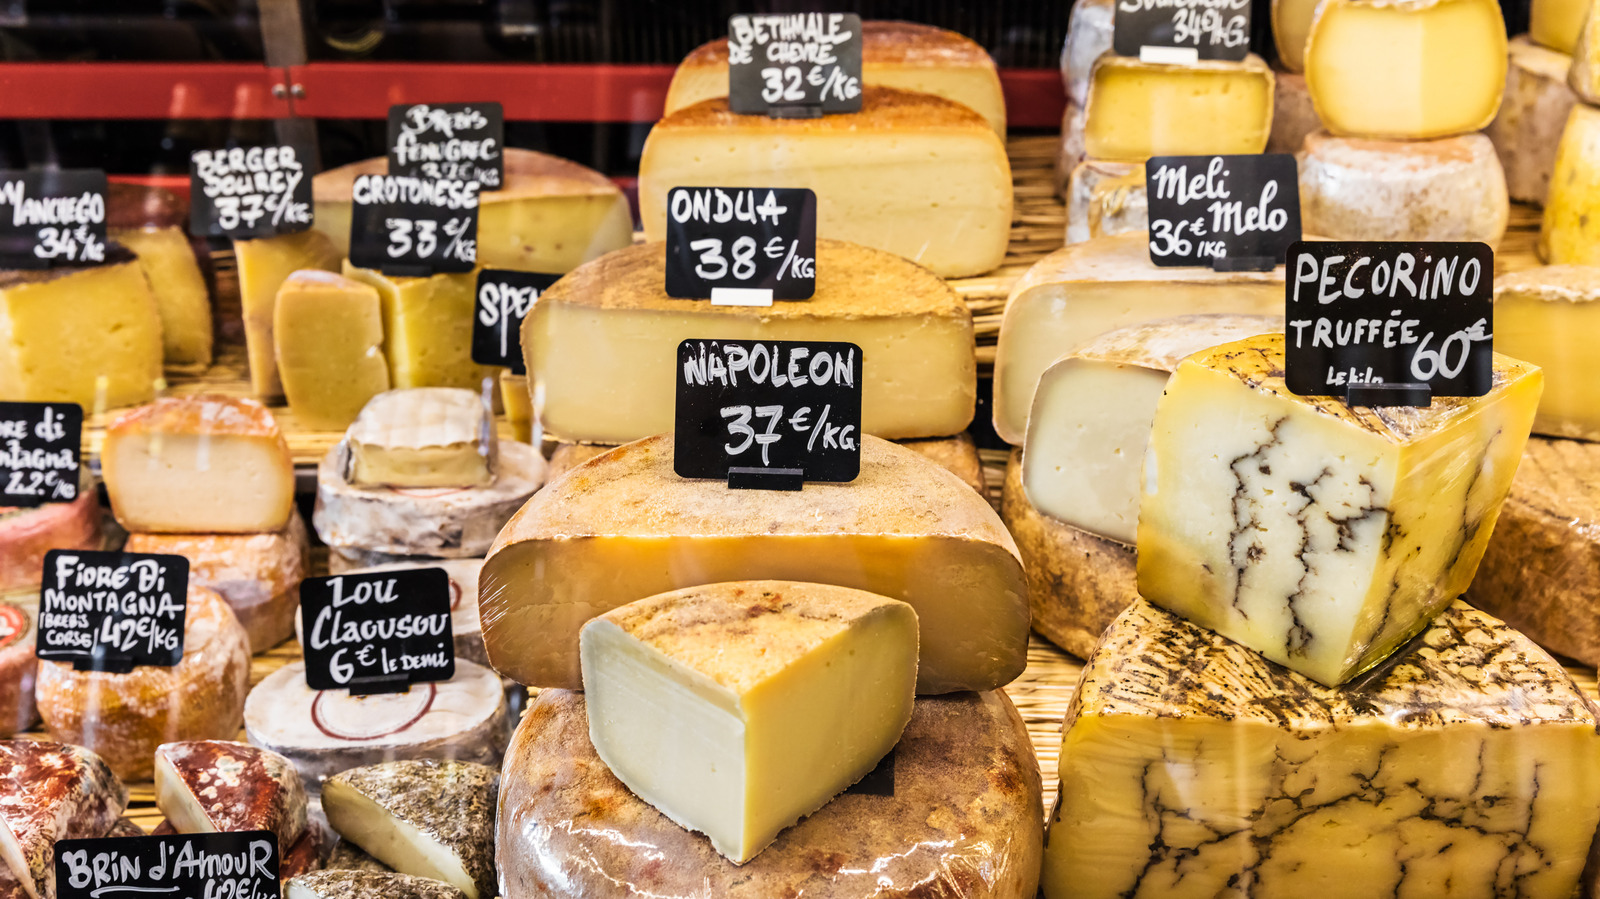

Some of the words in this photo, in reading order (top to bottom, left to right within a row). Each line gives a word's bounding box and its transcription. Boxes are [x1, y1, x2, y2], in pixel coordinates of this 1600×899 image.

[731, 12, 853, 45] BETHMALE
[727, 40, 753, 65] DE
[192, 145, 303, 178] BERGER
[353, 174, 481, 210] CROTONESE
[1151, 156, 1231, 206] Meli
[671, 188, 788, 226] ONDUA
[1206, 179, 1288, 236] Melo
[1289, 309, 1420, 348] TRUFFÉE
[683, 341, 854, 389] NAPOLEON
[44, 588, 185, 620] MONTAGNA
